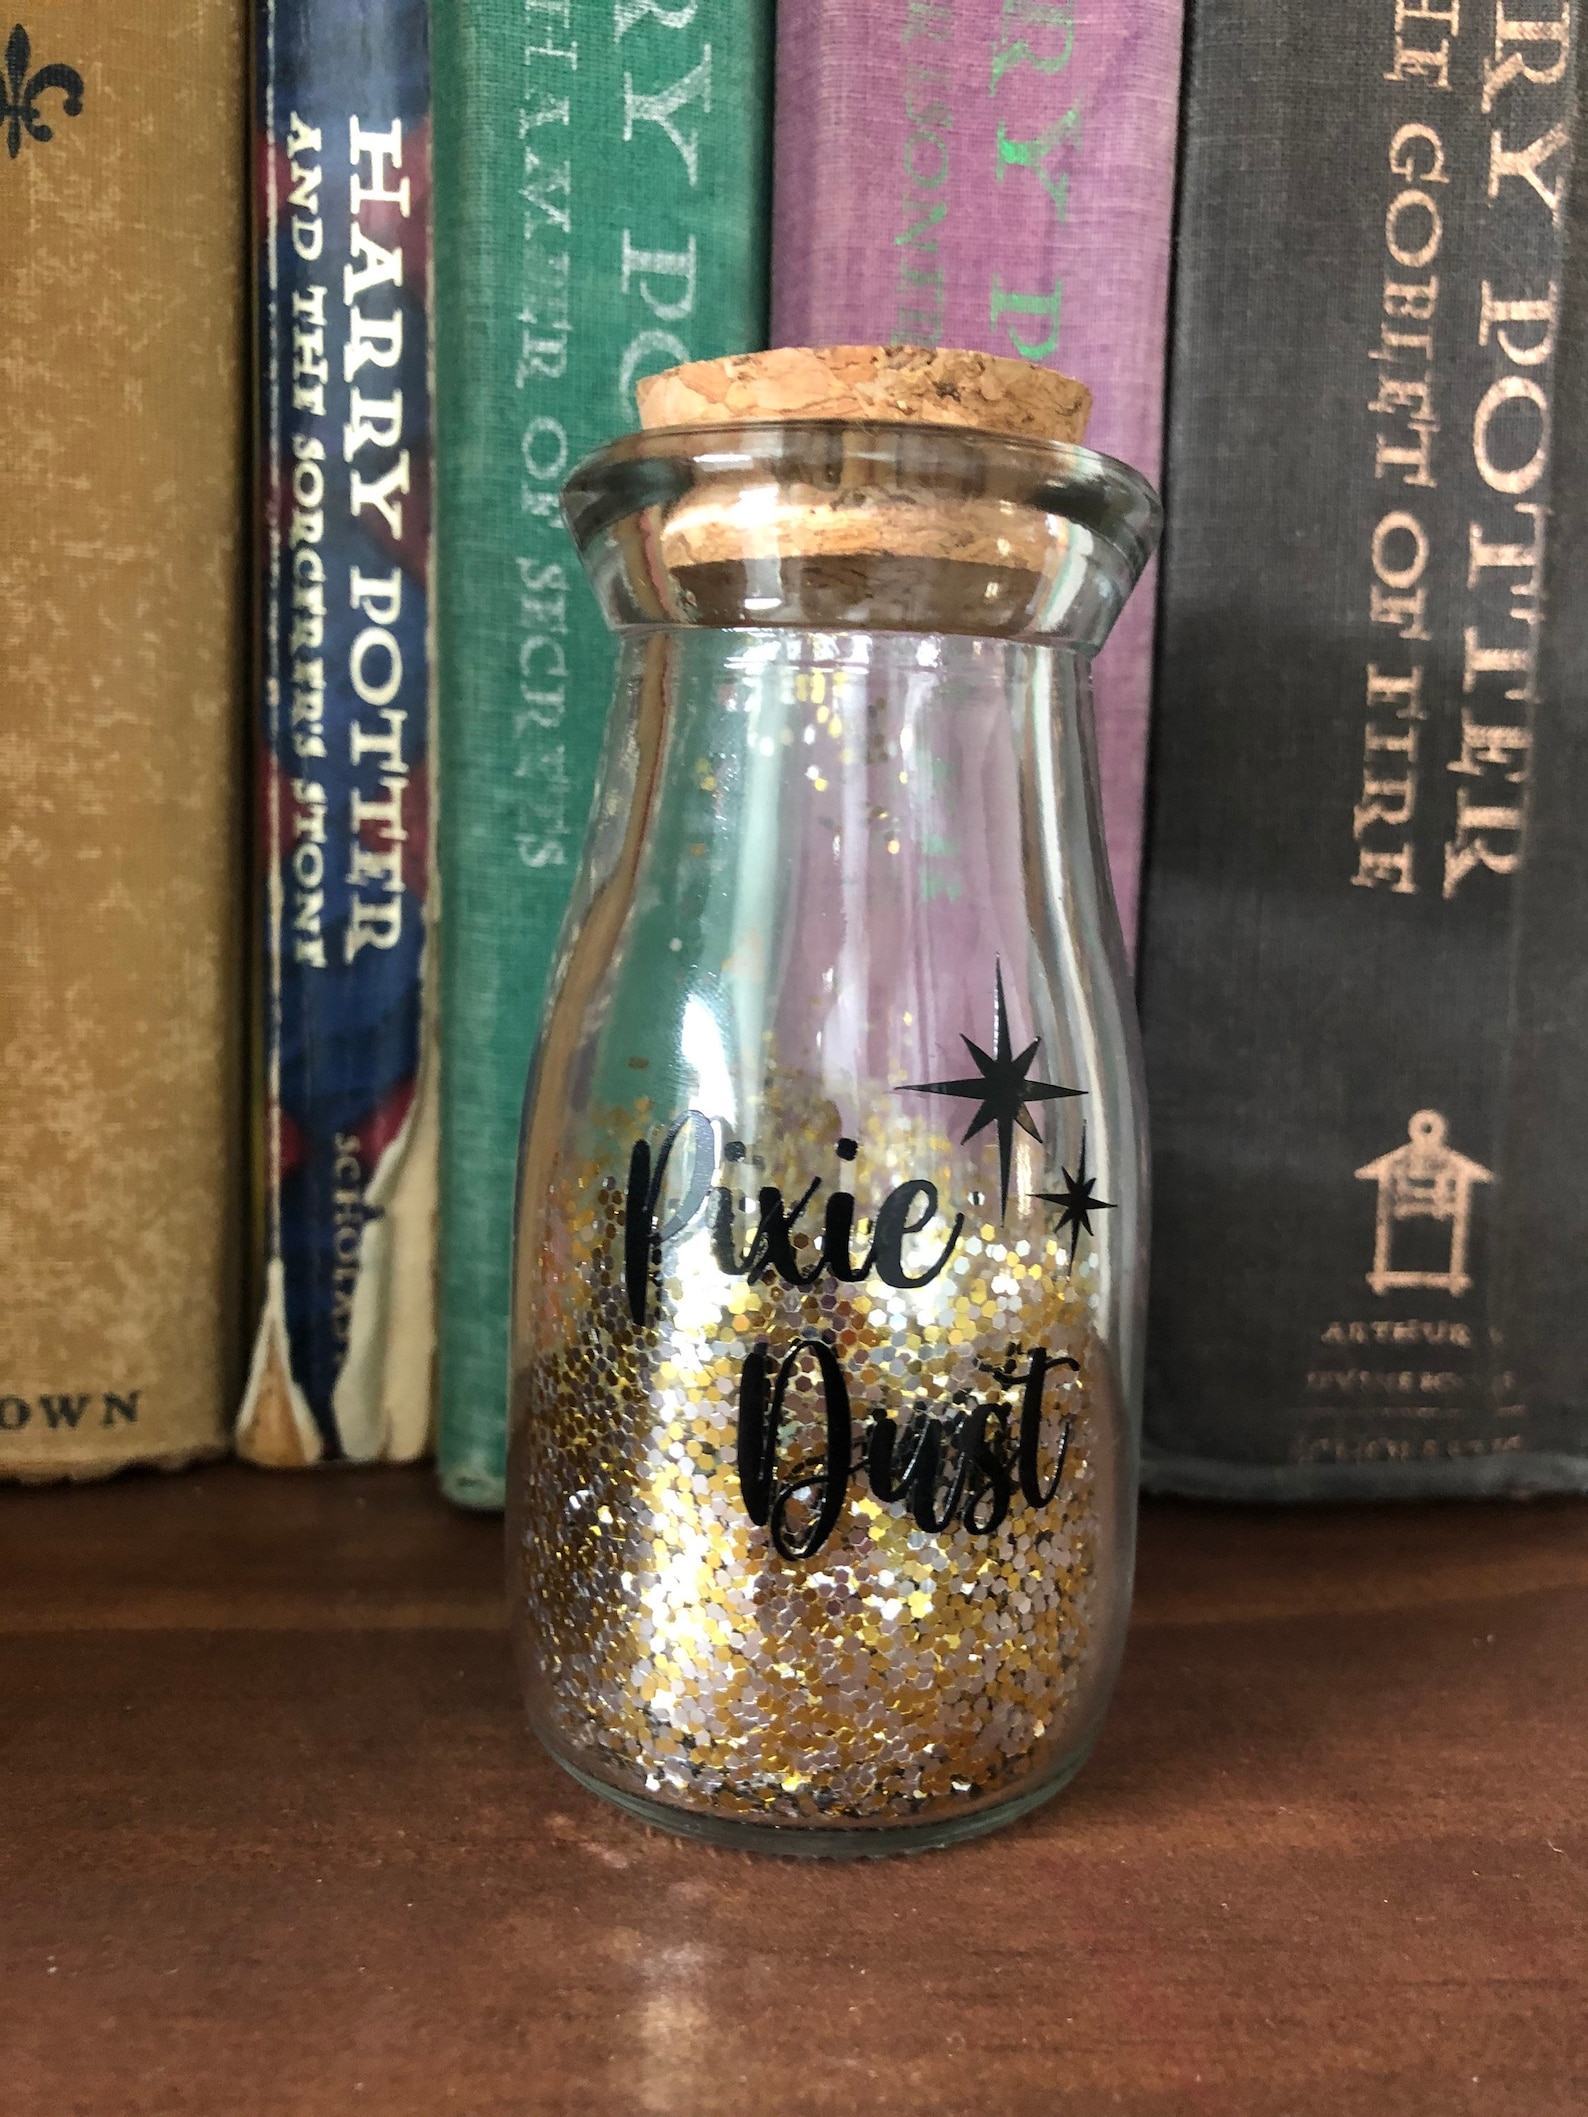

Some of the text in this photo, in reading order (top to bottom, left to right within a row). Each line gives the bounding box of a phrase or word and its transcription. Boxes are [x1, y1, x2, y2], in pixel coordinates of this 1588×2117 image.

[1368, 123, 1449, 488] GOBLET
[286, 111, 328, 968] AND THE SORCERER'S STONE
[344, 114, 411, 964] HARRY POTTER
[521, 416, 566, 529] OF
[1369, 510, 1433, 641] OF
[1443, 279, 1560, 900] POTTER
[516, 555, 571, 869] SECRETS
[1350, 663, 1428, 896] FIRE
[625, 1109, 965, 1326] Pixie
[738, 1339, 1080, 1562] Dust
